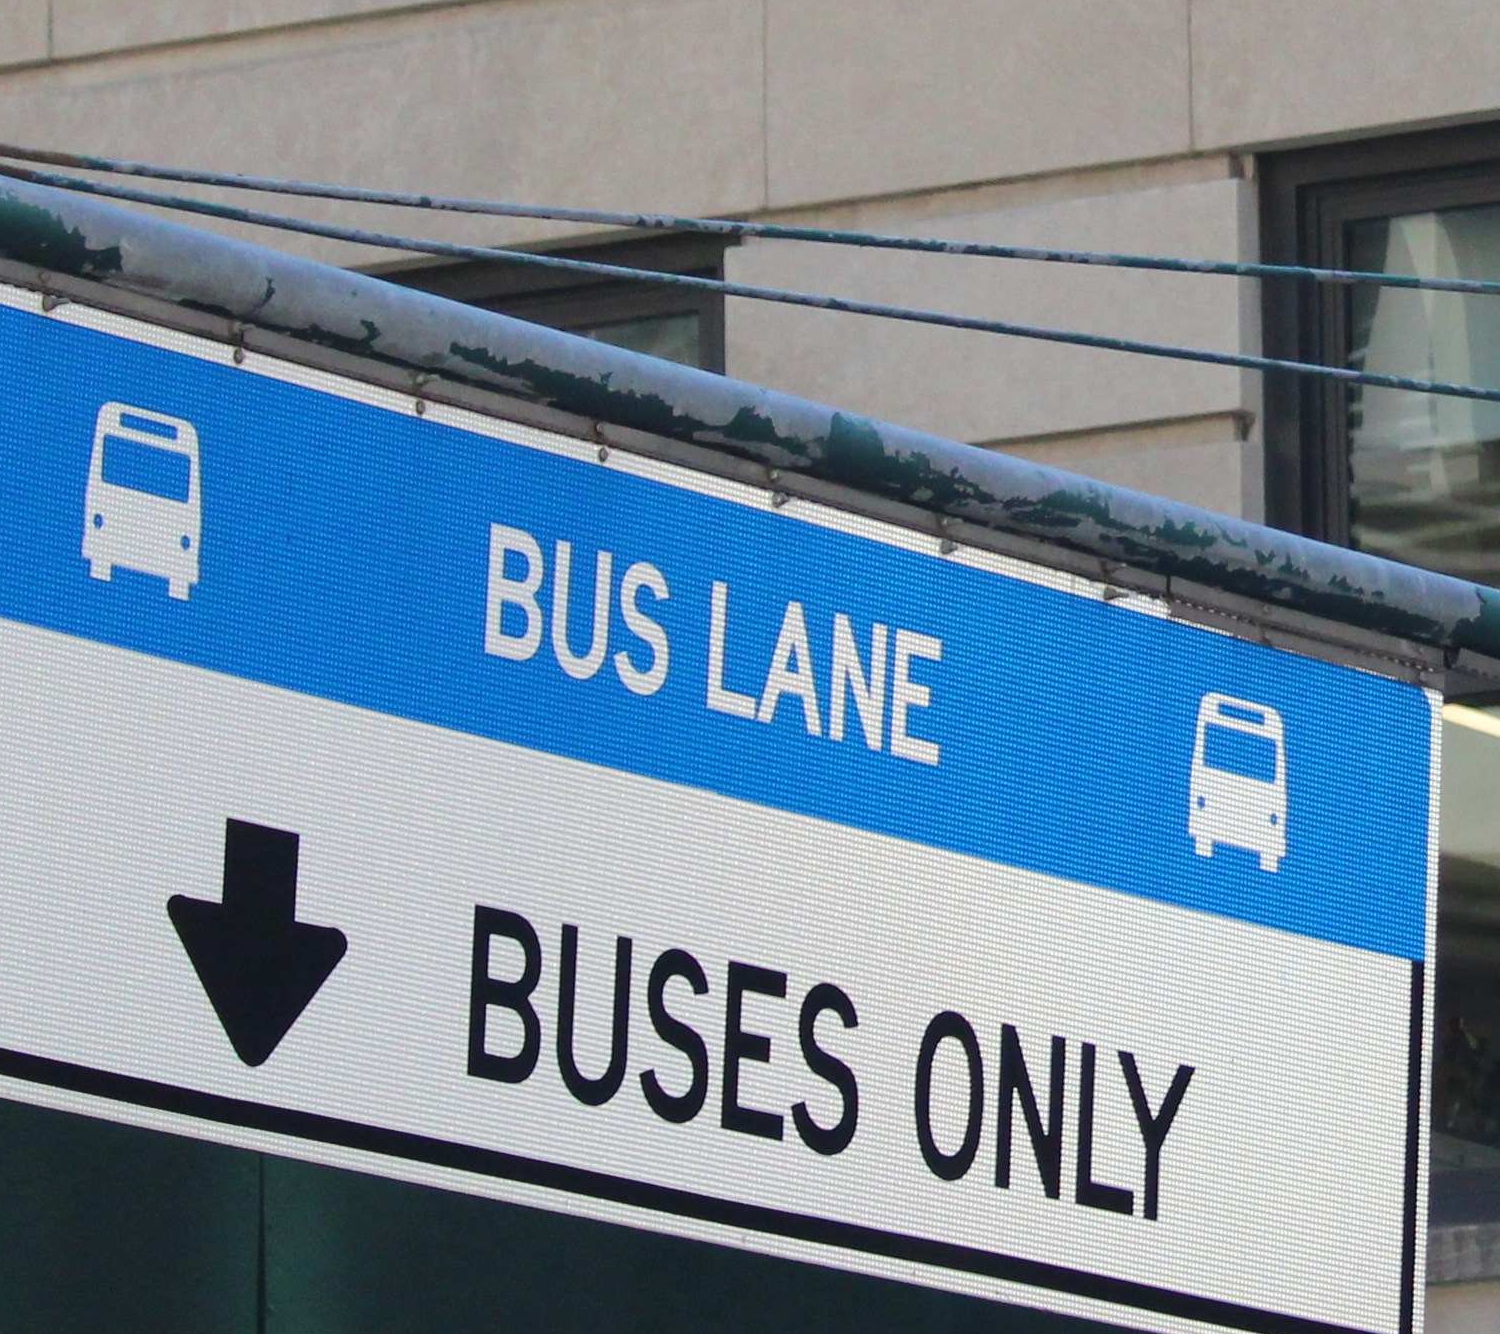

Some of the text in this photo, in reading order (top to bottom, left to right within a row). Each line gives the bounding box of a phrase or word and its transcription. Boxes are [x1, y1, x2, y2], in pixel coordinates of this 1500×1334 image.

[484, 522, 943, 766] BUS LANE
[467, 904, 1196, 1221] BUSES ONLY
